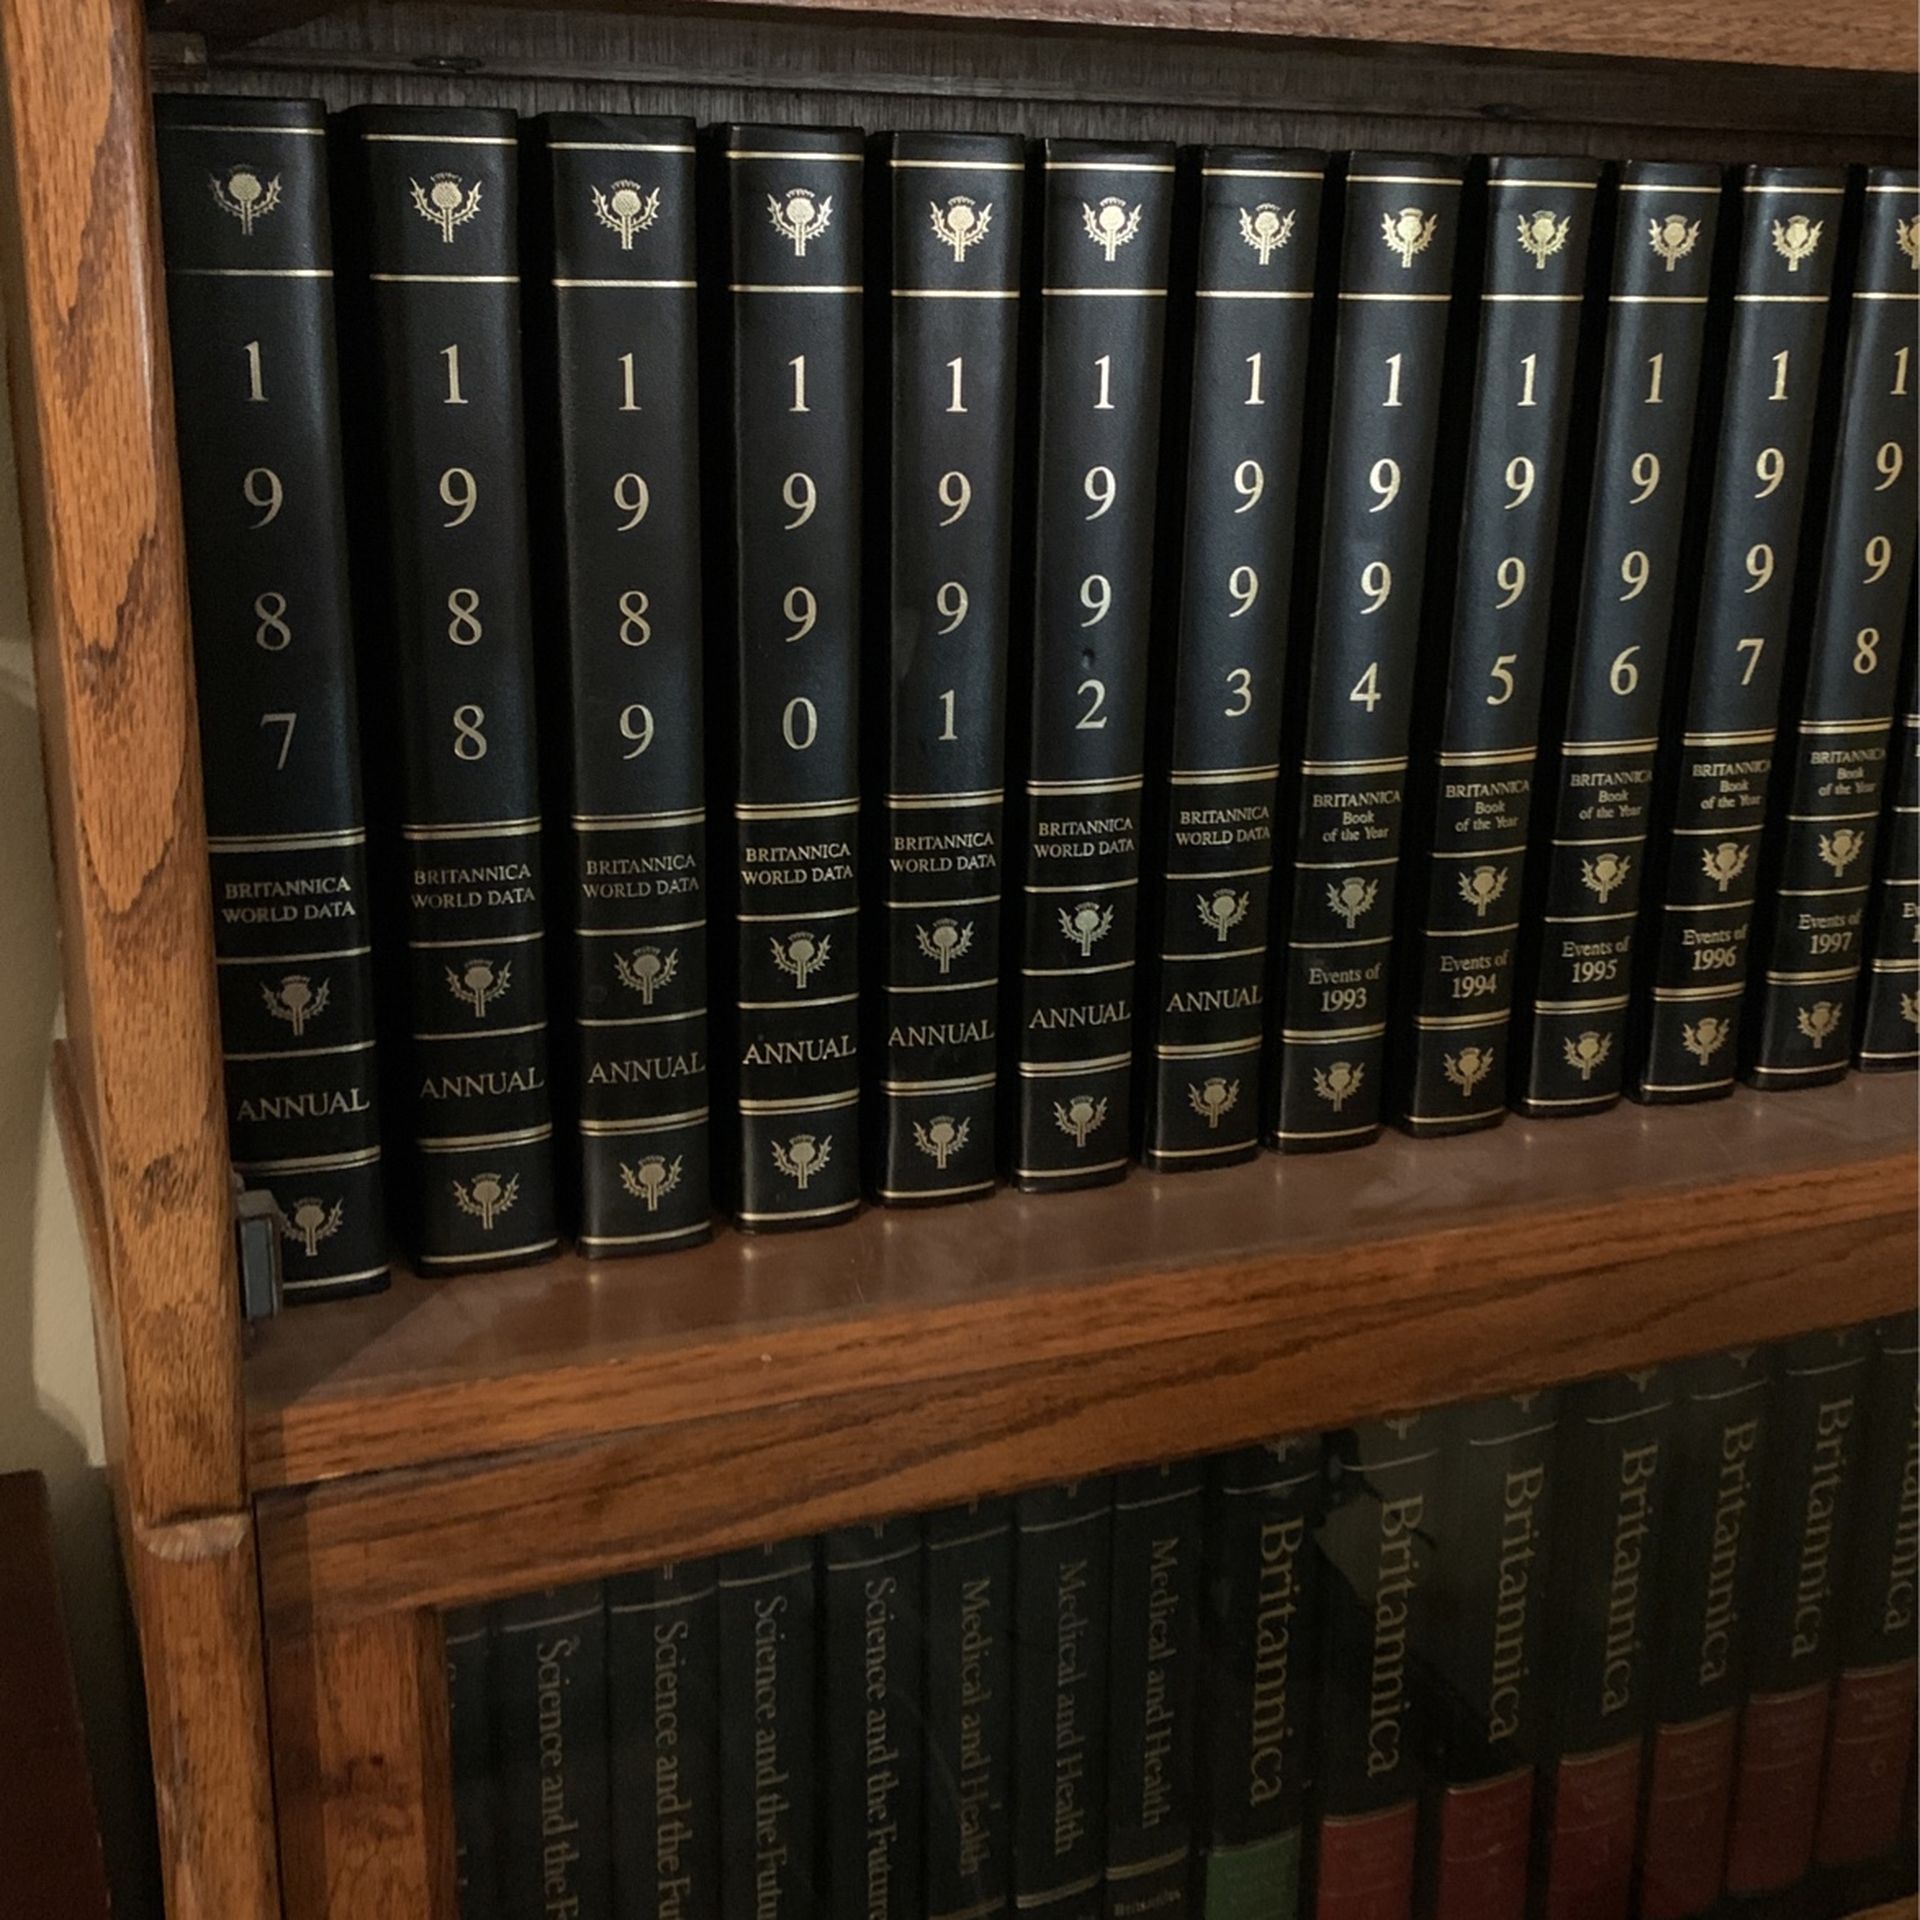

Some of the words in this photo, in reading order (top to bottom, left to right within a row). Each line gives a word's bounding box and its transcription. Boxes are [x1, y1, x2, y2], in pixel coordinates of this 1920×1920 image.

[1312, 790, 1400, 808] BRITANNICA
[1445, 780, 1531, 798] BRITANNICA
[1598, 790, 1630, 803] Book
[1179, 805, 1270, 826] BRITANNICA
[1342, 810, 1375, 825] Book
[1455, 818, 1470, 832] of
[1472, 818, 1491, 831] the
[1495, 815, 1519, 829] Year
[1474, 801, 1506, 815] Book
[1579, 807, 1595, 820] of
[1596, 807, 1615, 819] the
[893, 831, 994, 852] BRITANNICA
[1037, 816, 1134, 838] BRITANNICA
[1175, 826, 1231, 846] WORLD
[1235, 824, 1271, 843] DATA
[1322, 828, 1339, 842] of
[1341, 828, 1360, 841] the
[1364, 826, 1390, 840] Year
[745, 841, 851, 864] BRITANNICA
[889, 855, 952, 874] WORLD
[955, 851, 996, 870] DATA
[1033, 838, 1095, 860] WORLD
[1098, 836, 1136, 856] DATA
[413, 862, 532, 885] BRITANNICA
[585, 853, 697, 876] BRITANNICA
[741, 864, 807, 886] WORLD
[811, 862, 854, 882] DATA
[225, 875, 352, 899] BRITANNICA
[411, 887, 481, 909] WORLD
[488, 885, 536, 905] DATA
[582, 878, 652, 899] WORLD
[656, 874, 700, 895] DATA
[222, 903, 298, 925] WORLD
[304, 899, 356, 920] DATA
[1561, 941, 1613, 958] Events
[1615, 935, 1632, 952] of
[1691, 945, 1738, 971] 1996
[1809, 931, 1853, 956] 1997
[1308, 967, 1361, 985] Events
[1365, 962, 1382, 981] of
[1440, 954, 1492, 972] Events
[1494, 949, 1511, 966] of
[1571, 960, 1618, 984] 1995
[1166, 984, 1263, 1014] ANNUAL
[1320, 988, 1367, 1012] 1993
[1451, 973, 1497, 998] 1994
[1028, 999, 1131, 1030] ANNUAL
[888, 1018, 995, 1048] ANNUAL
[742, 1034, 857, 1066] ANNUAL
[420, 1066, 545, 1099] ANNUAL
[587, 1051, 706, 1084] ANNUAL
[236, 1087, 370, 1122] ANNUAL
[1790, 1395, 1855, 1659] Britannica
[1882, 1400, 1918, 1635] annica
[1701, 1419, 1760, 1684] Britannica
[1601, 1441, 1659, 1717] Britannica
[1147, 1536, 1180, 1660] Medical
[1488, 1464, 1544, 1744] Britannica
[865, 1576, 897, 1702] Science
[1056, 1559, 1089, 1688] Medical
[1367, 1494, 1424, 1779] Britannica
[961, 1576, 992, 1706] Medical
[754, 1595, 788, 1721] Science
[1249, 1517, 1304, 1807] Britannica
[654, 1620, 689, 1749] Science
[1144, 1667, 1176, 1725] and
[537, 1637, 572, 1767] Science
[1056, 1693, 1086, 1749] and
[865, 1708, 899, 1769] and
[961, 1712, 992, 1772] and
[755, 1726, 790, 1787] and
[656, 1755, 693, 1816] and
[1141, 1726, 1173, 1830] Health
[541, 1774, 579, 1837] and
[866, 1769, 900, 1825] the
[1055, 1752, 1085, 1856] Health
[756, 1791, 791, 1844] the
[960, 1773, 991, 1876] Health
[657, 1820, 693, 1875] the
[543, 1839, 581, 1896] the
